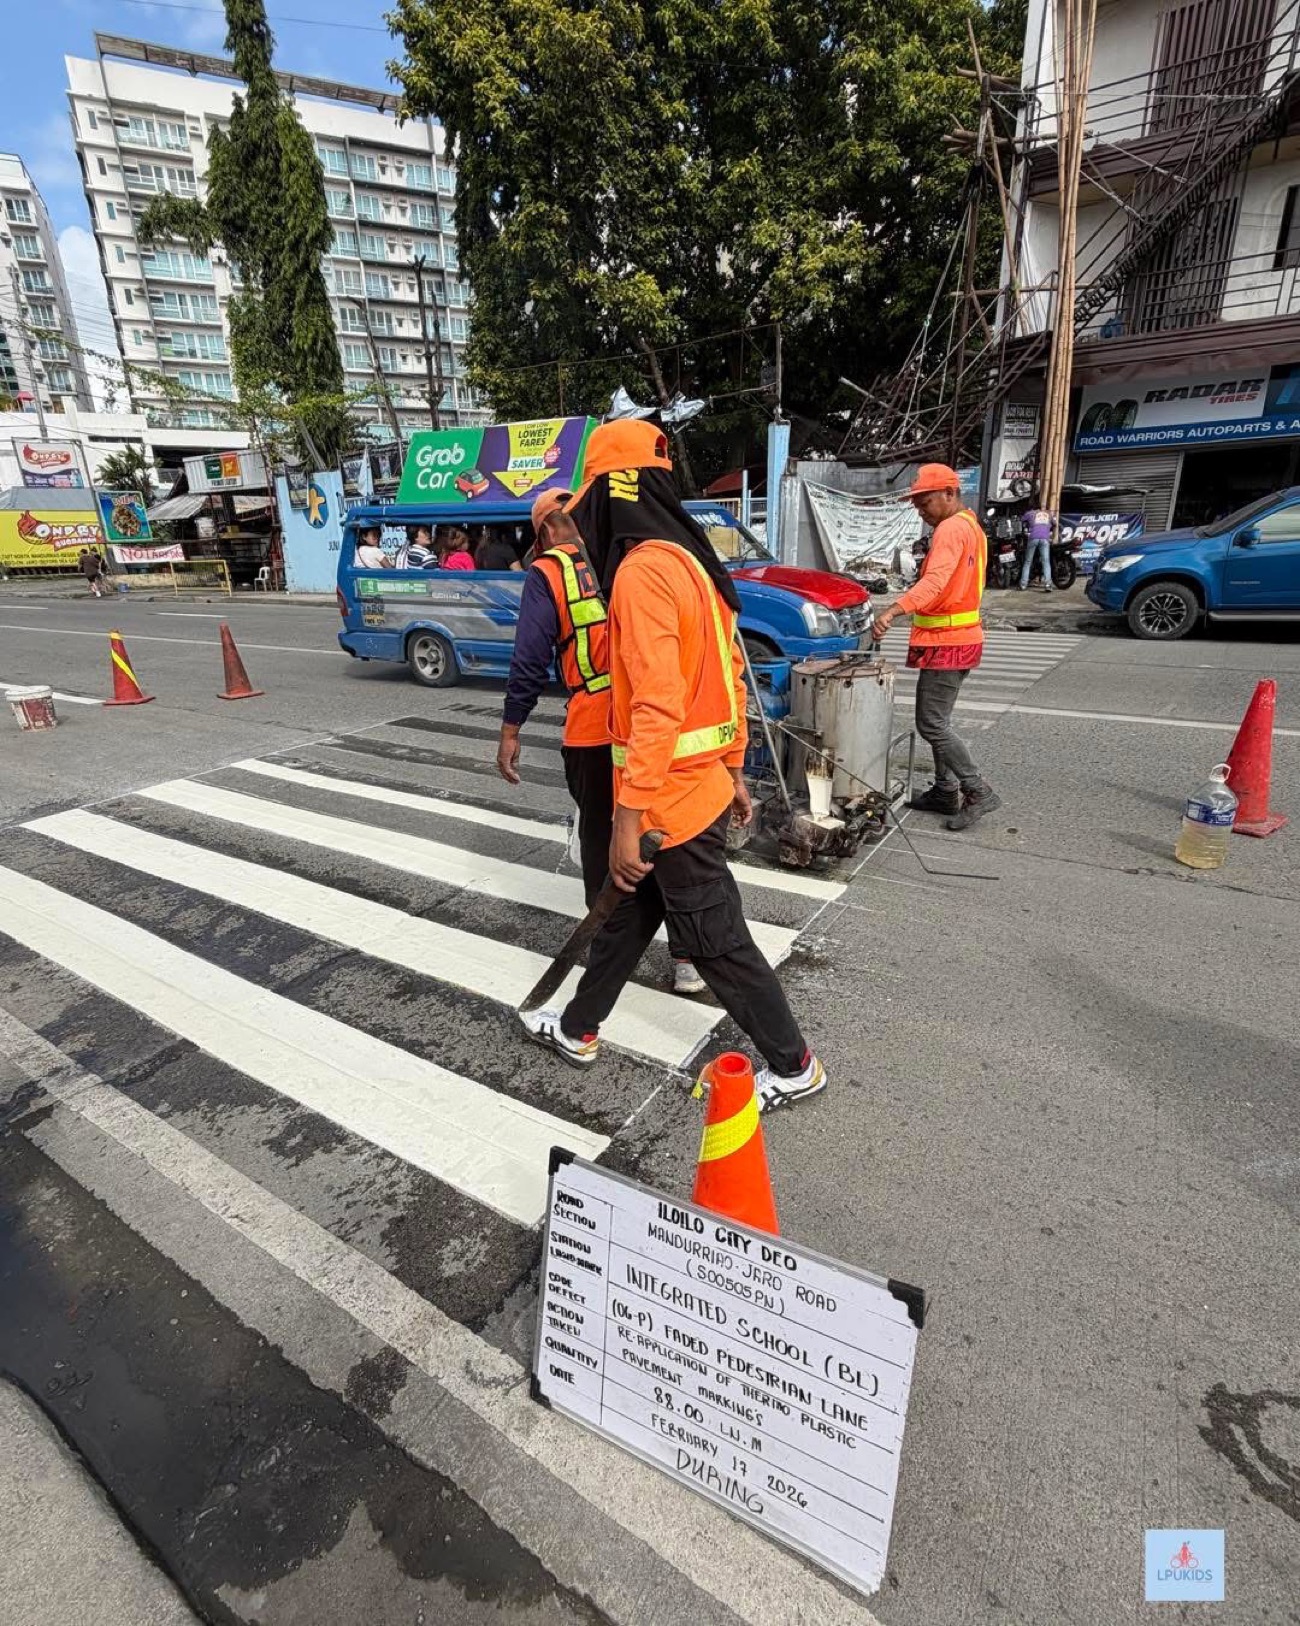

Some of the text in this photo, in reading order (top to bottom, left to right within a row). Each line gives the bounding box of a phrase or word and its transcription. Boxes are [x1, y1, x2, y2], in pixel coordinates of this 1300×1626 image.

[1143, 378, 1265, 404] RADAR
[1209, 392, 1258, 405] TIRES
[518, 428, 553, 438] LOWEST
[520, 438, 546, 447] FARES
[1080, 435, 1114, 446] ROAD
[1117, 430, 1184, 443] WARRIORS
[1187, 421, 1271, 438] AUTOPARTS
[1275, 421, 1287, 430] &
[416, 443, 465, 467] Grab
[512, 459, 544, 468] SAVER
[416, 468, 453, 489] Car
[1080, 514, 1118, 524] FALKEN
[1096, 523, 1129, 544] OFF
[553, 1203, 596, 1231] SECTION
[550, 1230, 592, 1255] STATION
[657, 1201, 704, 1235] ILOILO
[761, 1245, 798, 1272] DEO
[548, 1271, 573, 1289] CODE
[548, 1283, 586, 1305] DEFECT
[796, 1284, 837, 1313] ROAD
[547, 1300, 584, 1326] ACTION
[546, 1315, 581, 1337] TAKEN
[626, 1263, 879, 1397] INTEGRATED SCHOOL (BL)
[545, 1336, 598, 1369] QUANTITY
[549, 1363, 575, 1385] DATE
[622, 1348, 683, 1386] PAVEMENT
[664, 1325, 709, 1356] FADED
[716, 1348, 811, 1406] PEDESTRIAN
[821, 1398, 869, 1431] LANE
[617, 1325, 708, 1377] RE-APPLICATION
[715, 1372, 733, 1387] OF
[800, 1412, 857, 1450] PLASTIC
[653, 1386, 704, 1424] 88.00
[651, 1413, 809, 1509] FEBRUARY 17 2026
[676, 1447, 765, 1515] DURING
